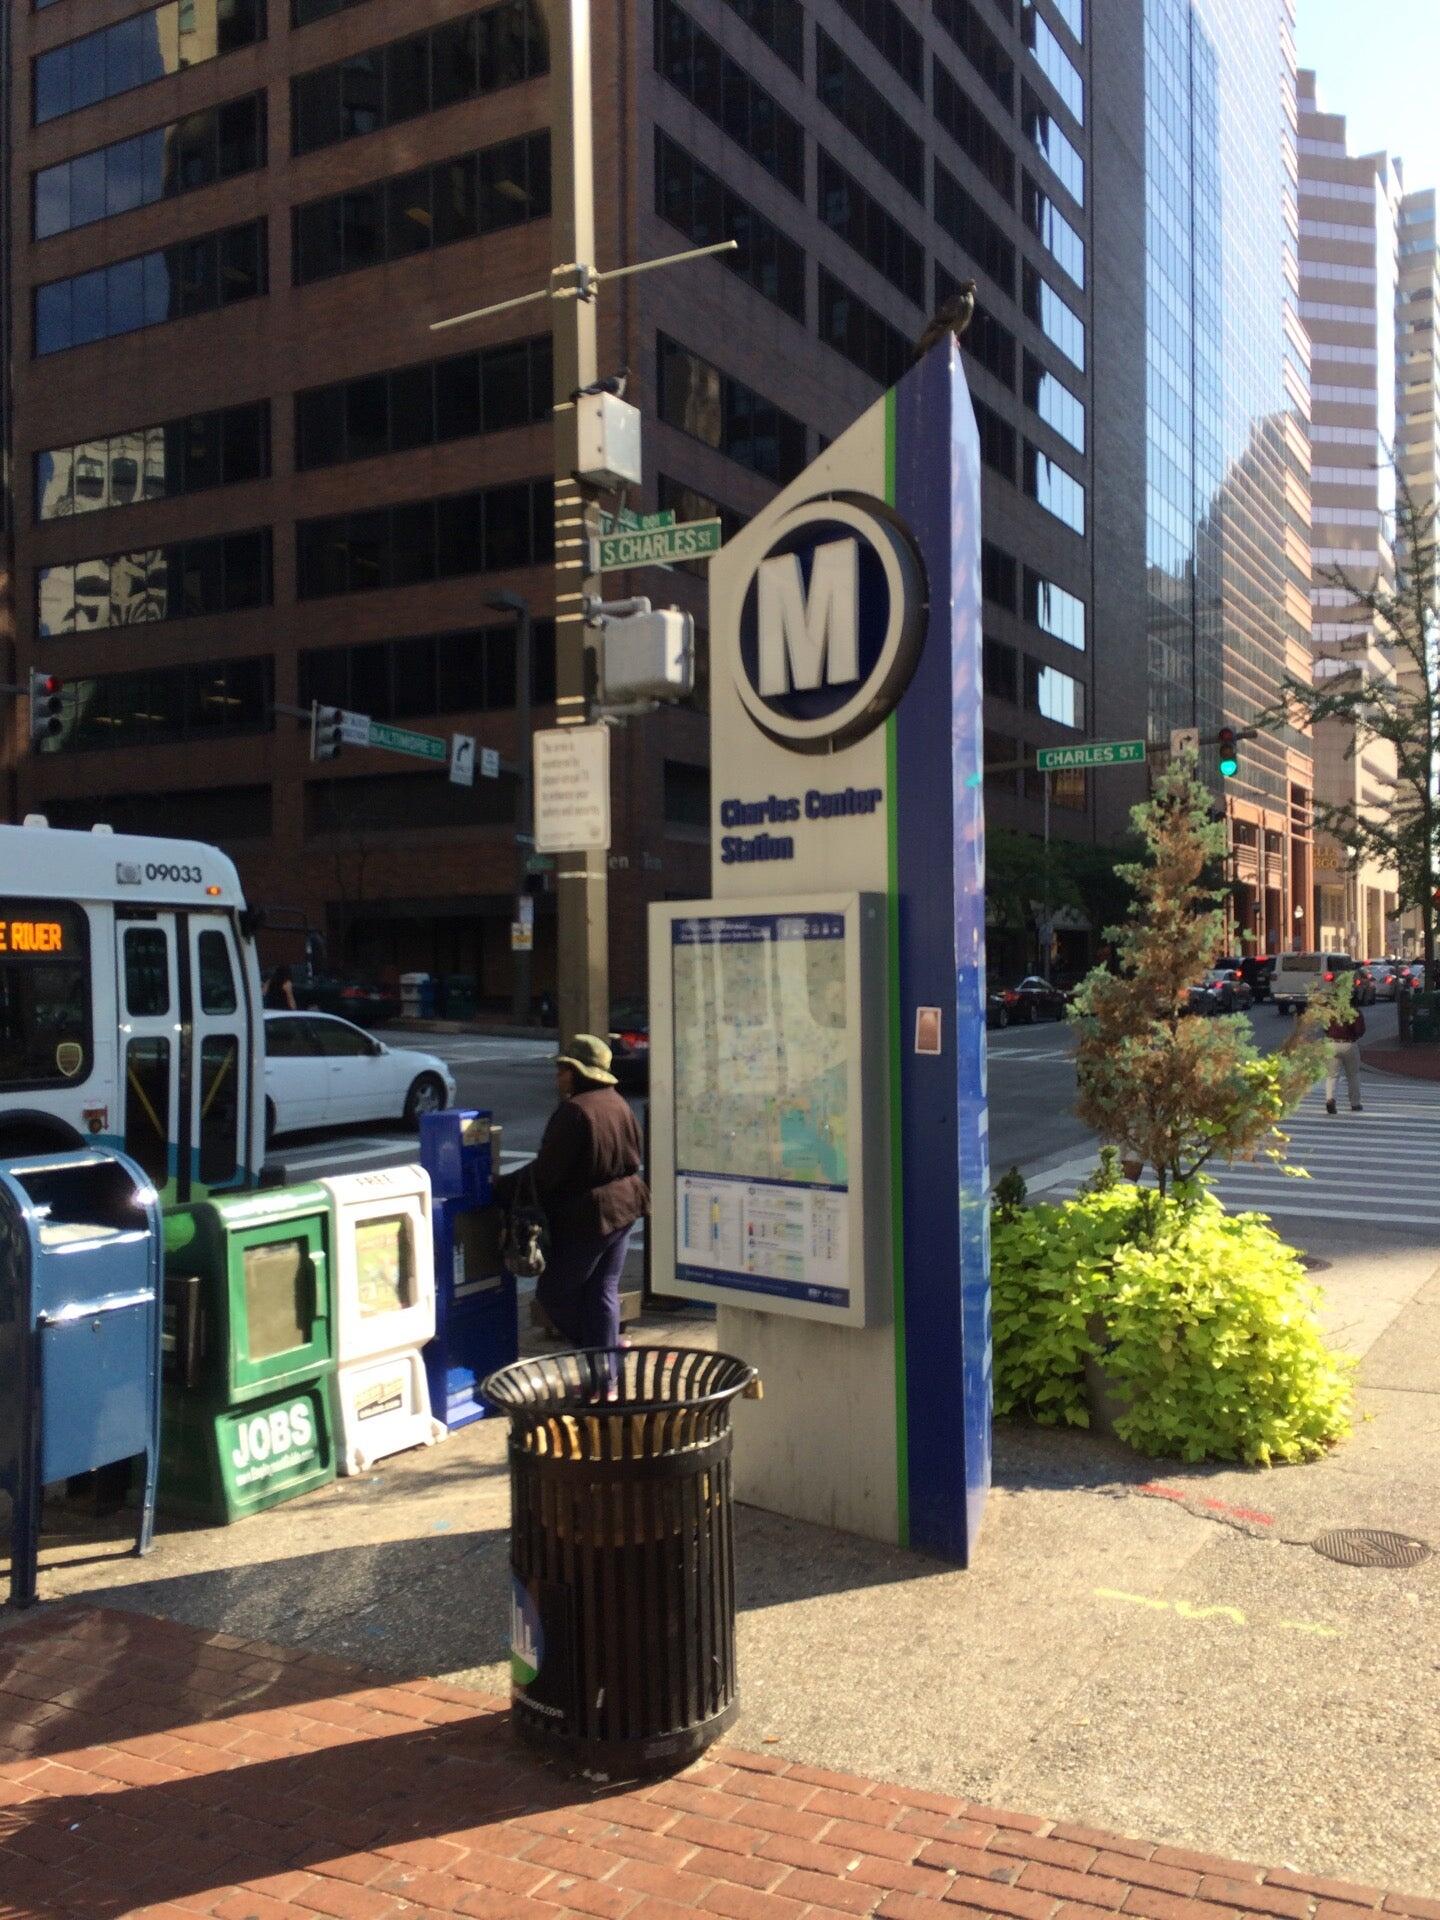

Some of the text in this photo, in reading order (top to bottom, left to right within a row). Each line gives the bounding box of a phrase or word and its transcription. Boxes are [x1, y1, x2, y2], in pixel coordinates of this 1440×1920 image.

[604, 541, 616, 565] S
[619, 529, 697, 562] CHARLES
[758, 537, 860, 697] M
[1045, 746, 1139, 766] CHARLES ST.
[721, 787, 882, 828] Charles Center
[721, 832, 794, 864] Station
[146, 863, 202, 883] 09033
[12, 922, 62, 951] RIVER
[232, 1403, 312, 1469] JOBS
